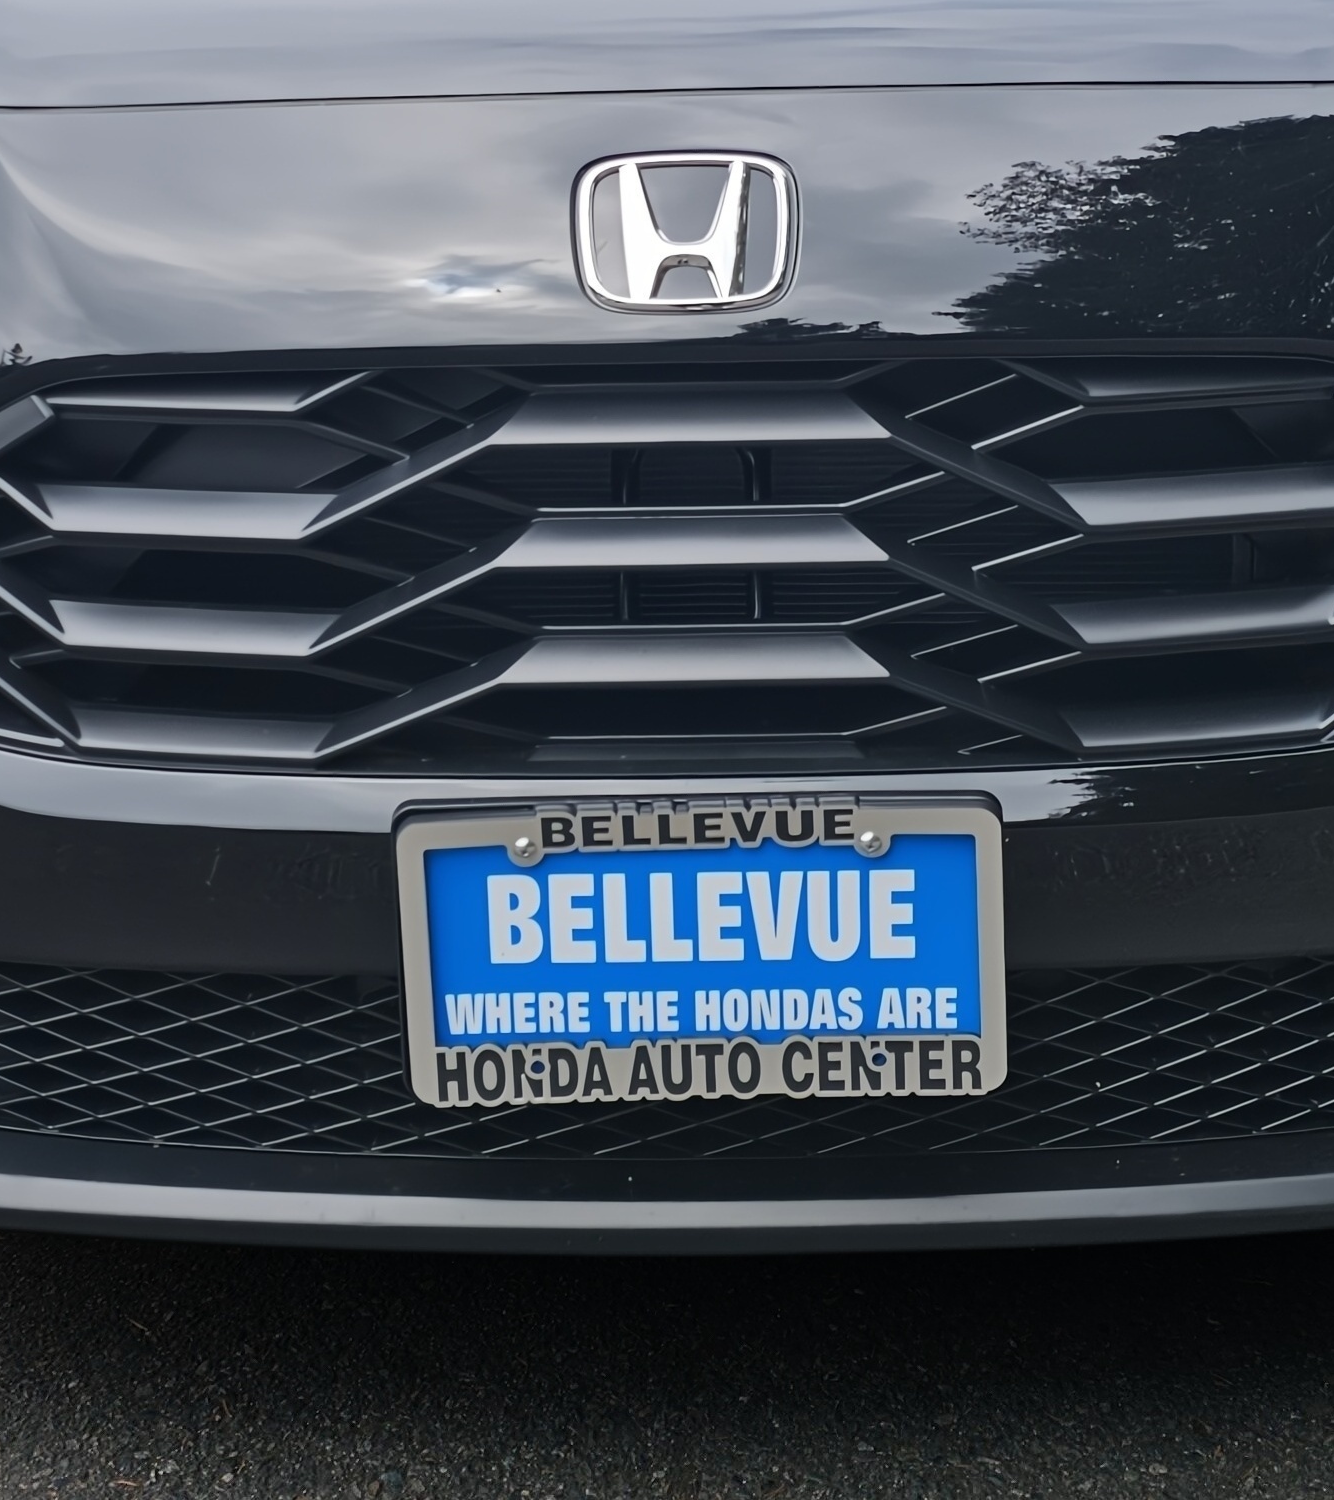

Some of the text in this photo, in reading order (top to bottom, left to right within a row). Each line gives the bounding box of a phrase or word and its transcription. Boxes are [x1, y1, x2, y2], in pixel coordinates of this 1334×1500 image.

[540, 808, 855, 849] BELLEVUE
[486, 868, 916, 965] BELLEVUE
[444, 986, 959, 1036] WHERE THE HONDAS ARE
[435, 1039, 983, 1102] HONDA AUTO CENTER
